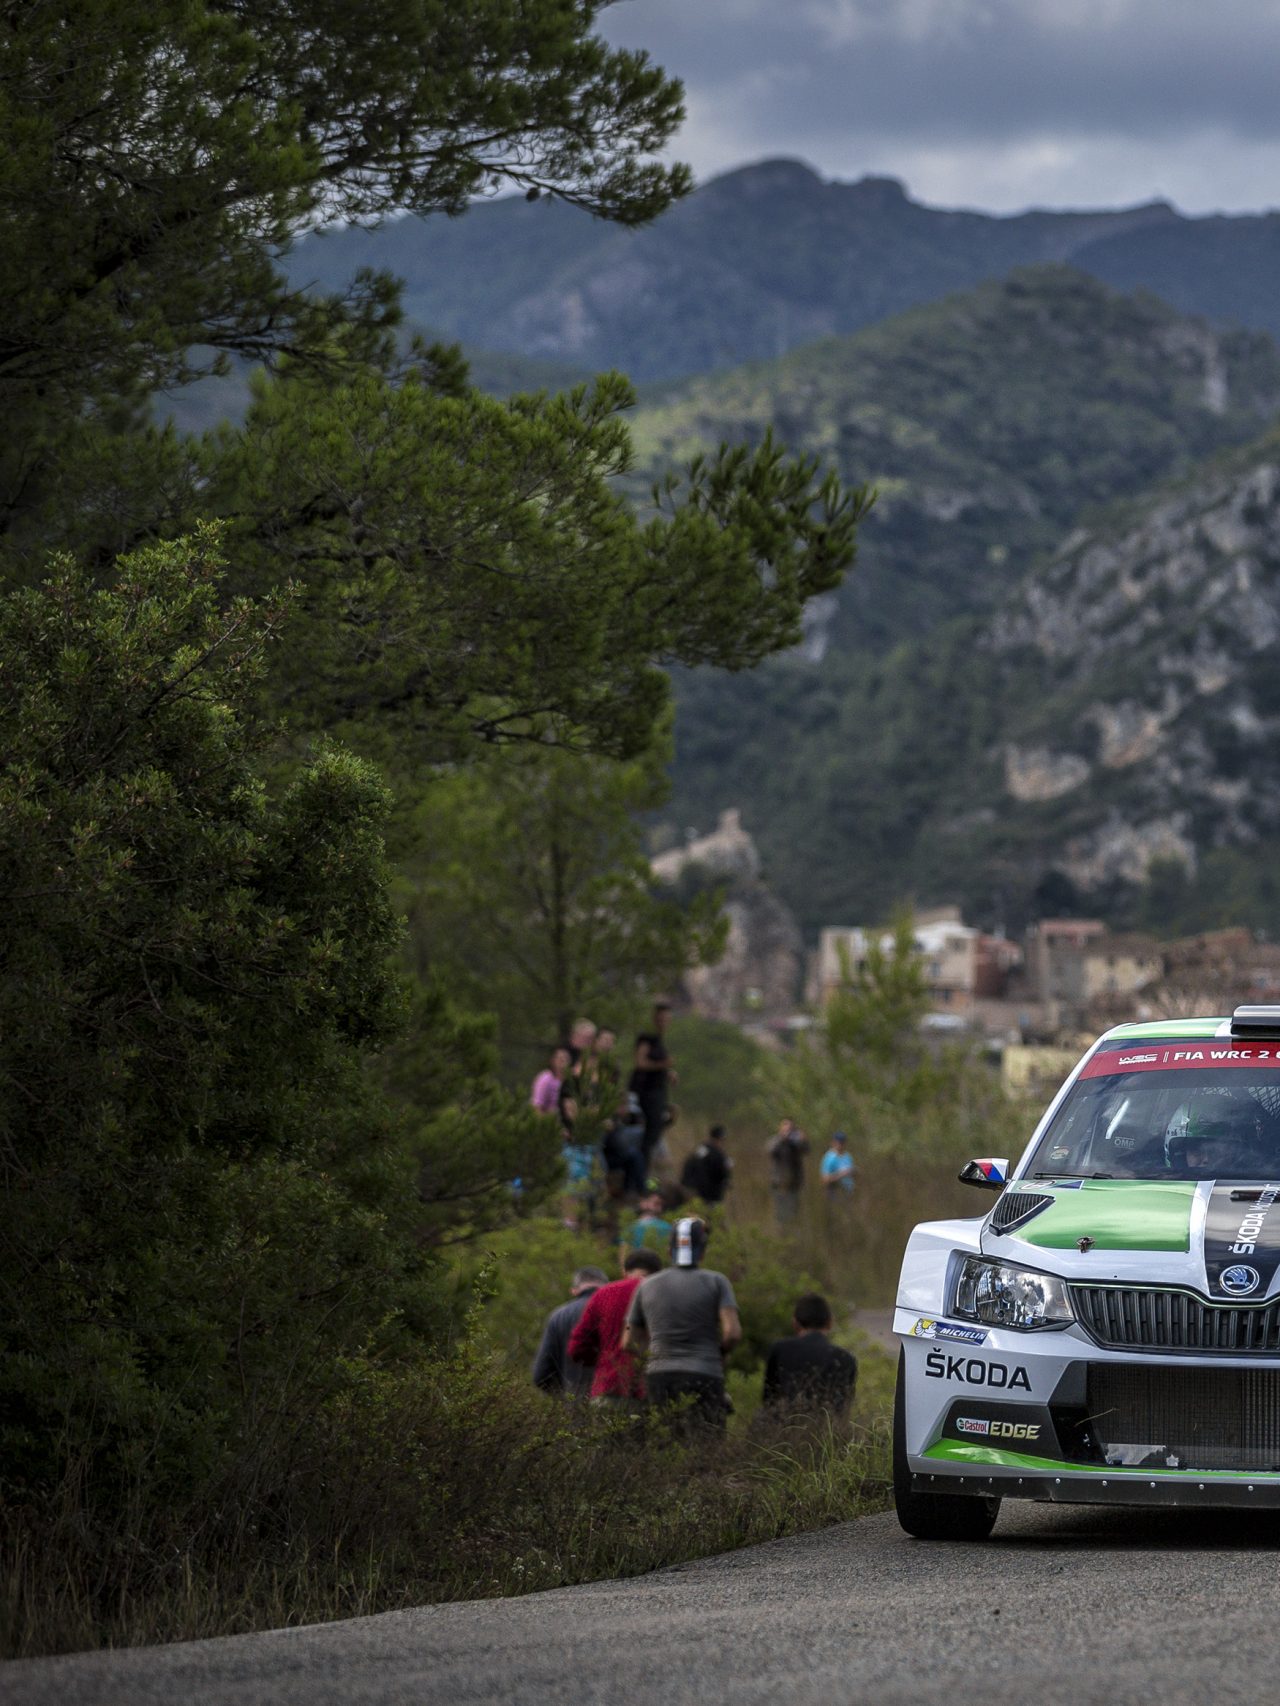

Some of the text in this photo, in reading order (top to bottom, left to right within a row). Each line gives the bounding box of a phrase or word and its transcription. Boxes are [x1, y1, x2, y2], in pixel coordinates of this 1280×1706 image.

[1174, 1051, 1204, 1060] FIA
[1210, 1050, 1252, 1059] WRC
[1258, 1050, 1270, 1059] 2
[1227, 1212, 1267, 1255] ŠKODA
[939, 1326, 987, 1341] MICHELIN
[925, 1347, 1033, 1392] ŠKODA
[964, 1420, 1042, 1440] Castrol EDGE
